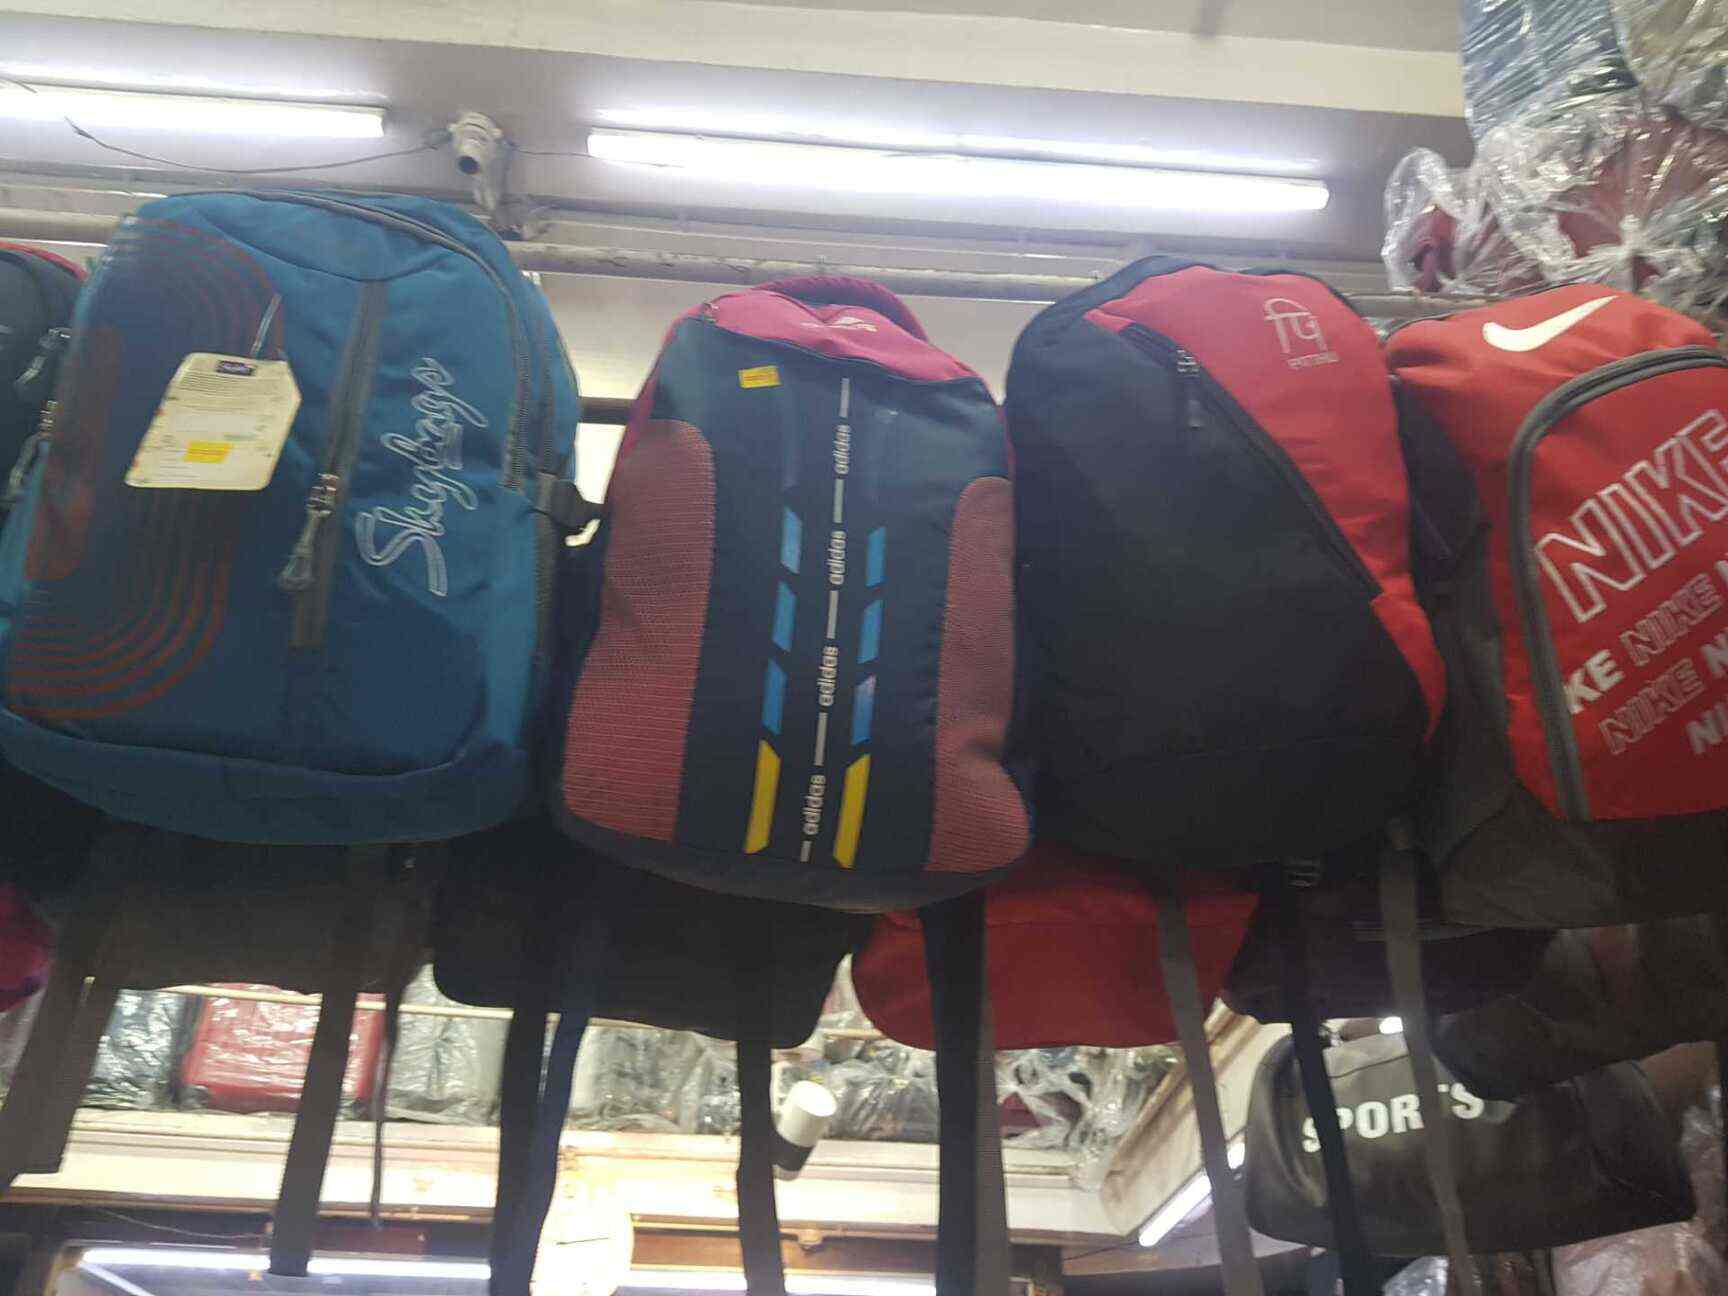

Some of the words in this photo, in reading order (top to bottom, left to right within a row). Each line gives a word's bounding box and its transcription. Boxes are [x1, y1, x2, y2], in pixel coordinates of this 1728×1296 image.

[355, 357, 489, 597] Skybags
[832, 424, 851, 475] adidas
[829, 530, 848, 585] adidas
[1564, 649, 1624, 715] KE
[1619, 573, 1723, 668] NIKE
[817, 645, 840, 707] adidas
[1599, 657, 1705, 756] NIKE
[803, 774, 828, 836] adidas
